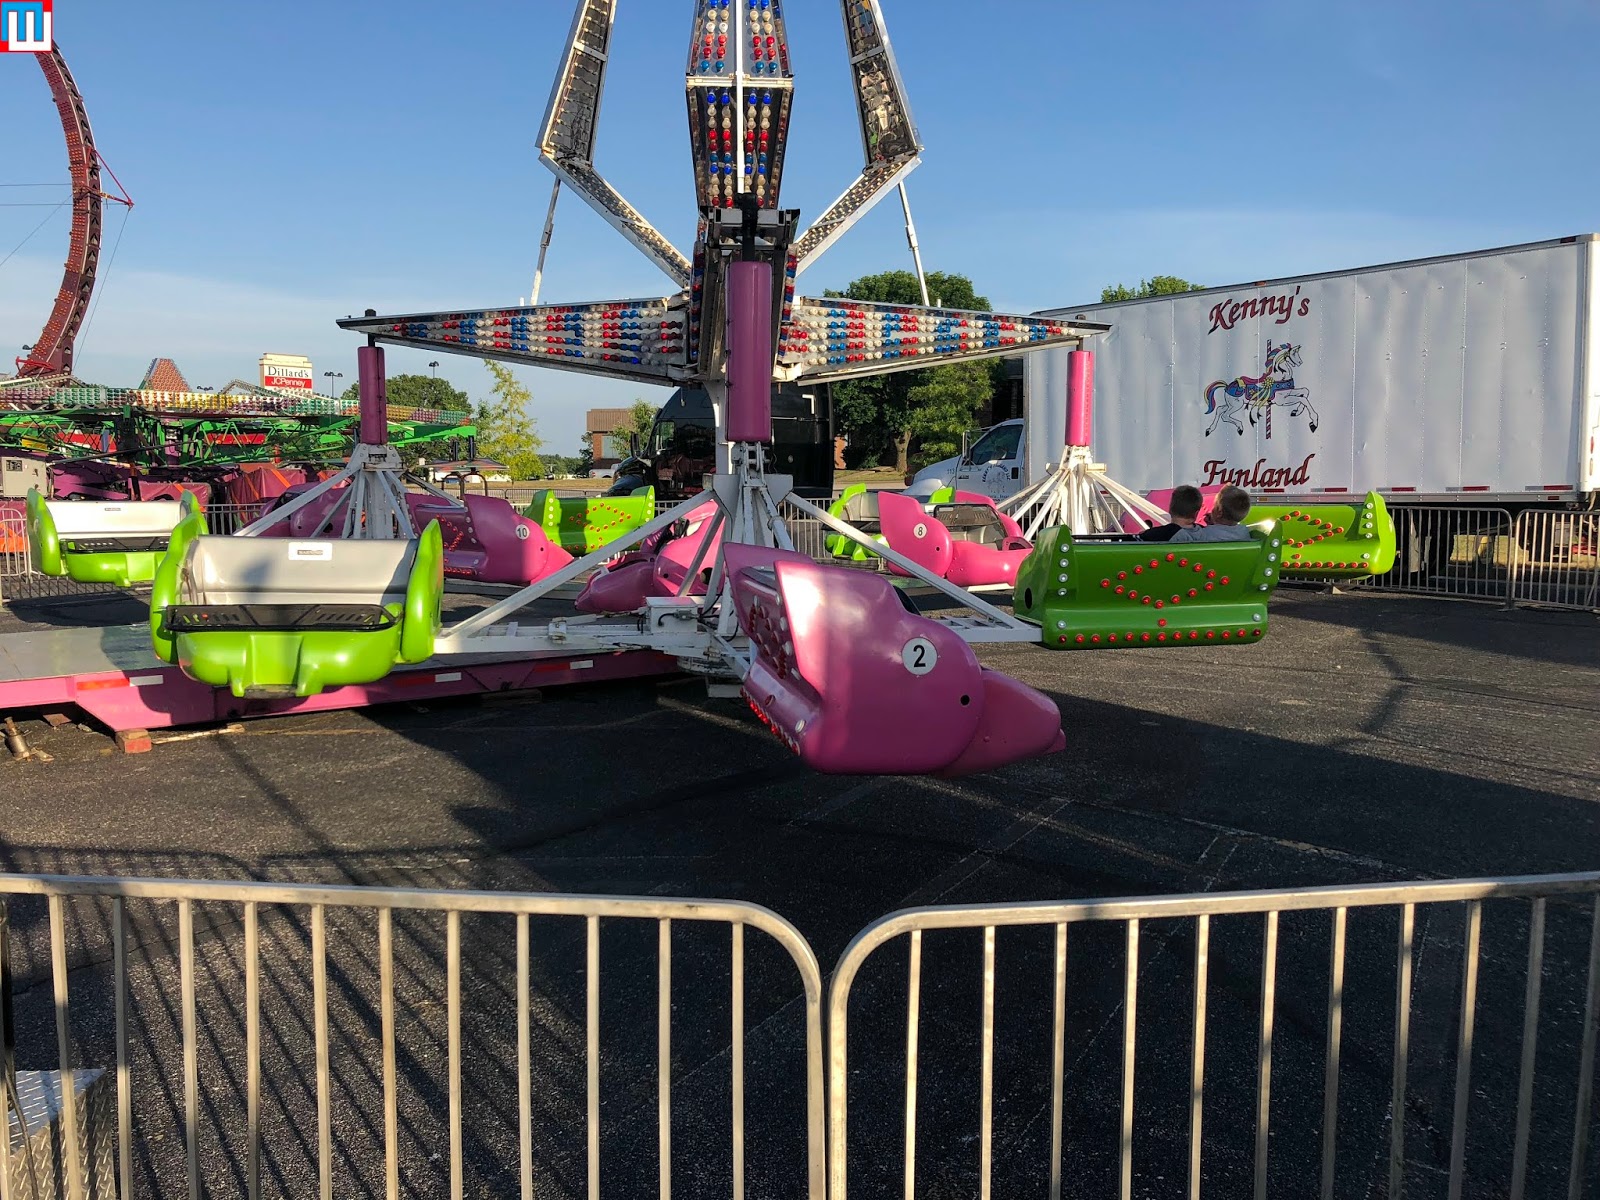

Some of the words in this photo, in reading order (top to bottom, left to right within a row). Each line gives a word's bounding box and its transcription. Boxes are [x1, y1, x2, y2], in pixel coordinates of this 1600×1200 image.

[1207, 285, 1311, 335] Kenny's
[267, 366, 309, 378] Dillard's
[271, 377, 306, 388] JCPenney
[1200, 453, 1316, 488] Funland
[517, 527, 528, 538] 10
[917, 526, 924, 536] 8
[912, 644, 926, 668] 2
